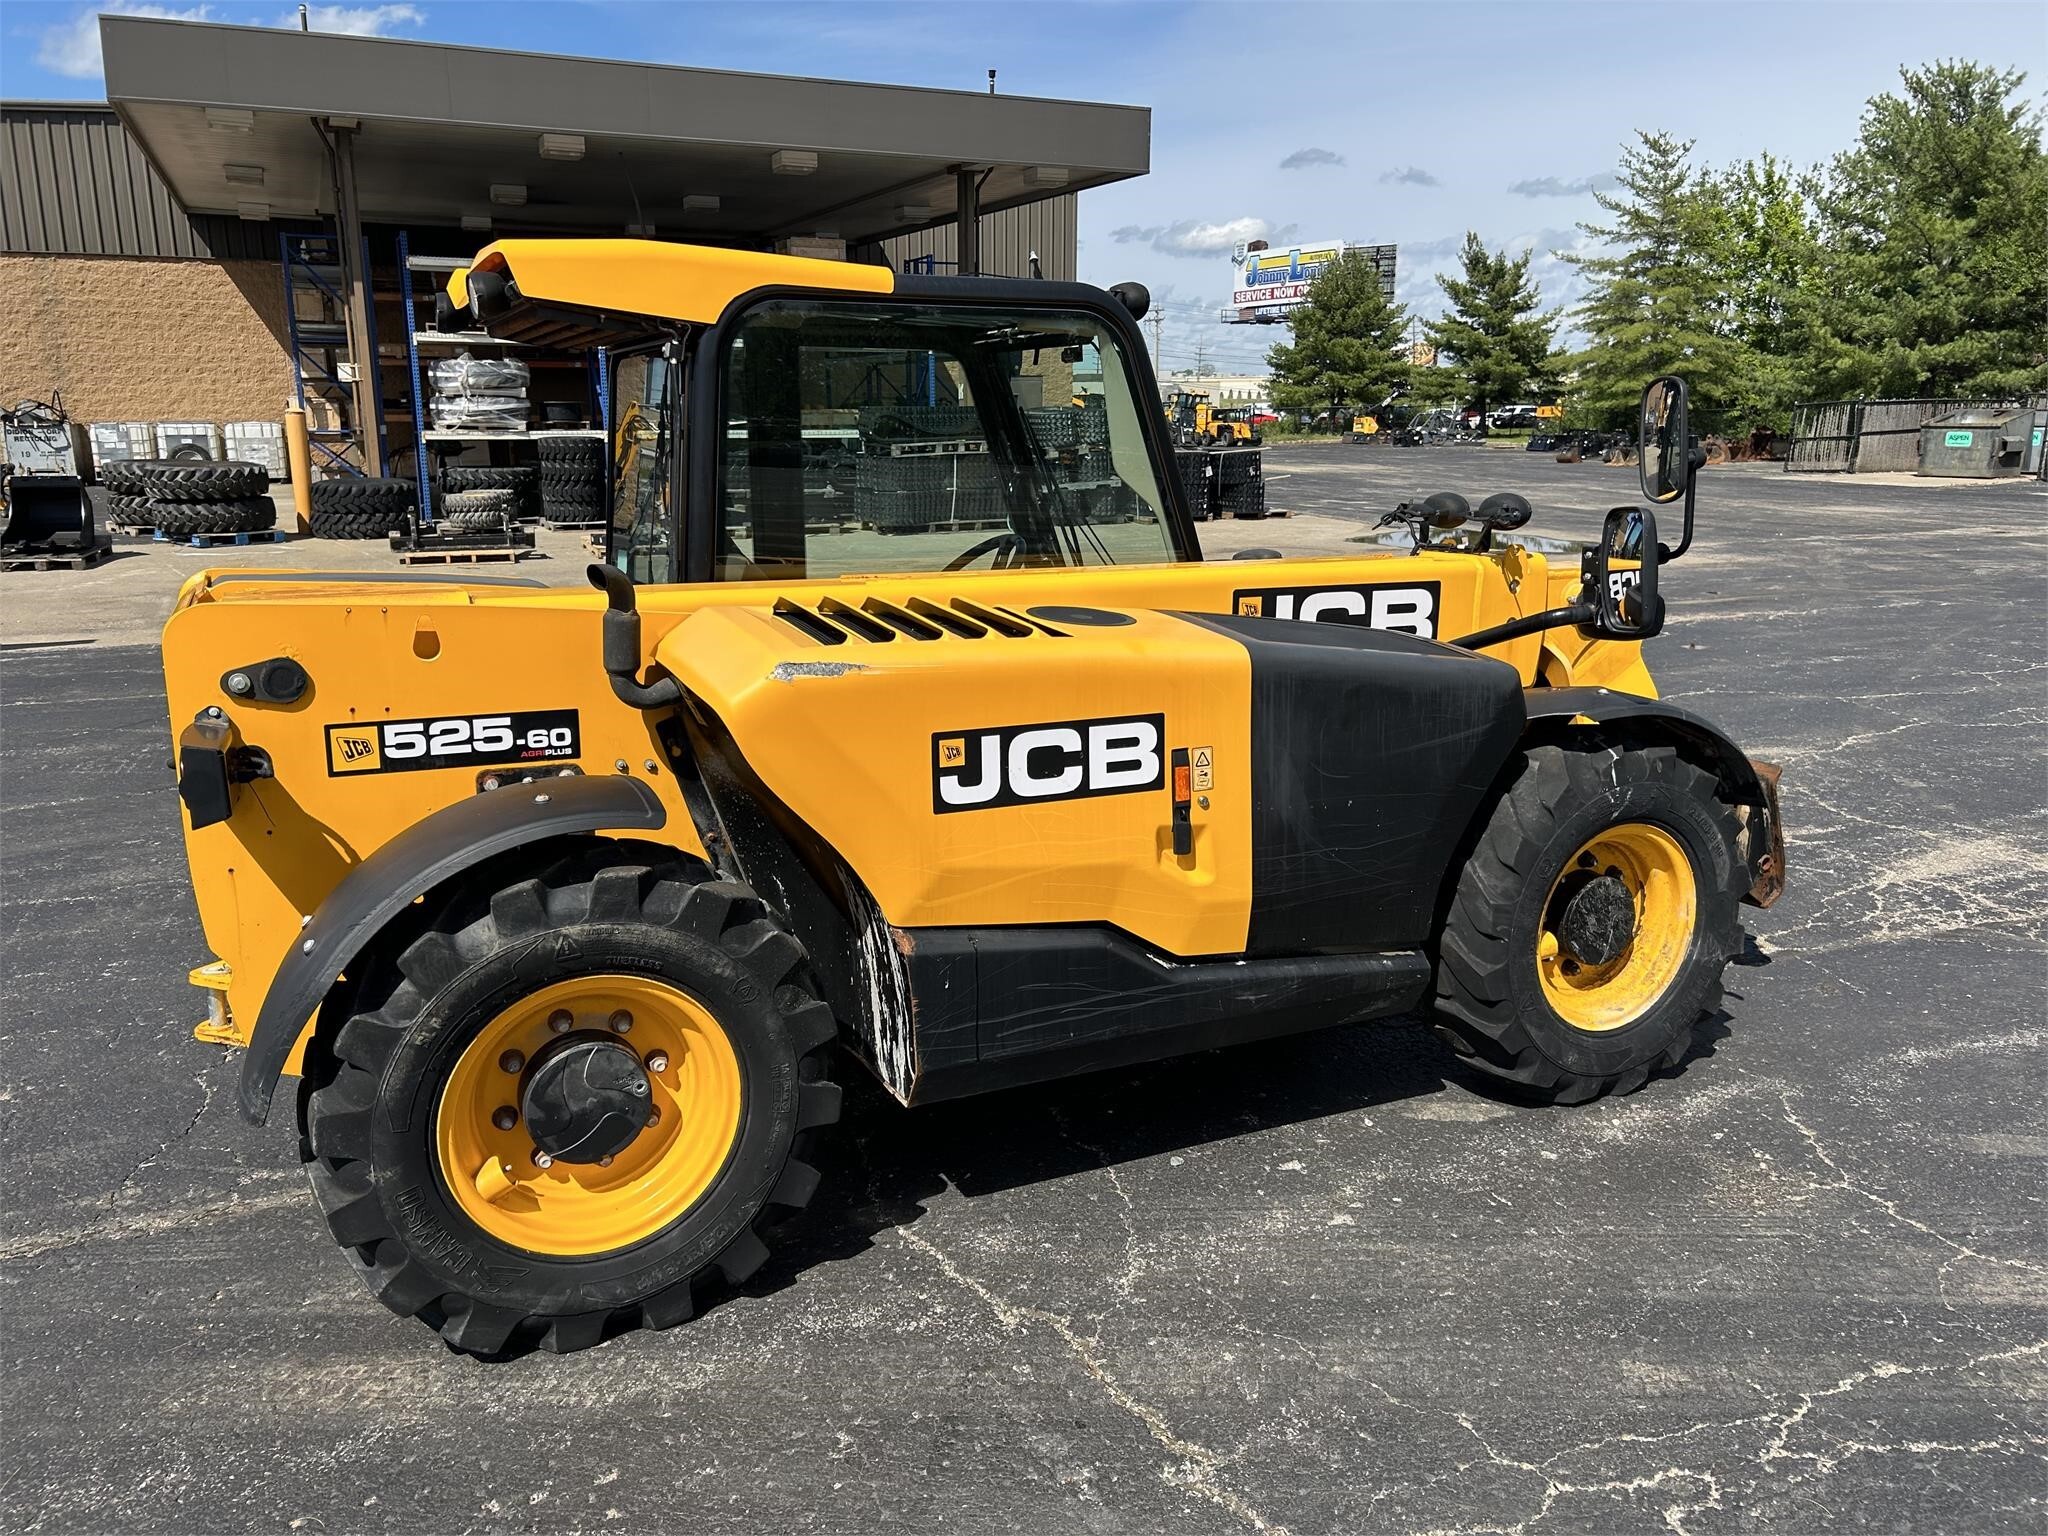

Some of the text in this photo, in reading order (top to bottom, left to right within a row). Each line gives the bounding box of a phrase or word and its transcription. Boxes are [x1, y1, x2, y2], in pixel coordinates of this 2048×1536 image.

[1246, 255, 1289, 287] Johnny
[1235, 285, 1309, 303] SERVICE NOW OP
[384, 716, 572, 759] 525-60
[343, 738, 372, 760] JCB
[520, 747, 573, 759] AGRIPLUS
[946, 746, 961, 760] JCB
[939, 721, 1160, 805] JCB
